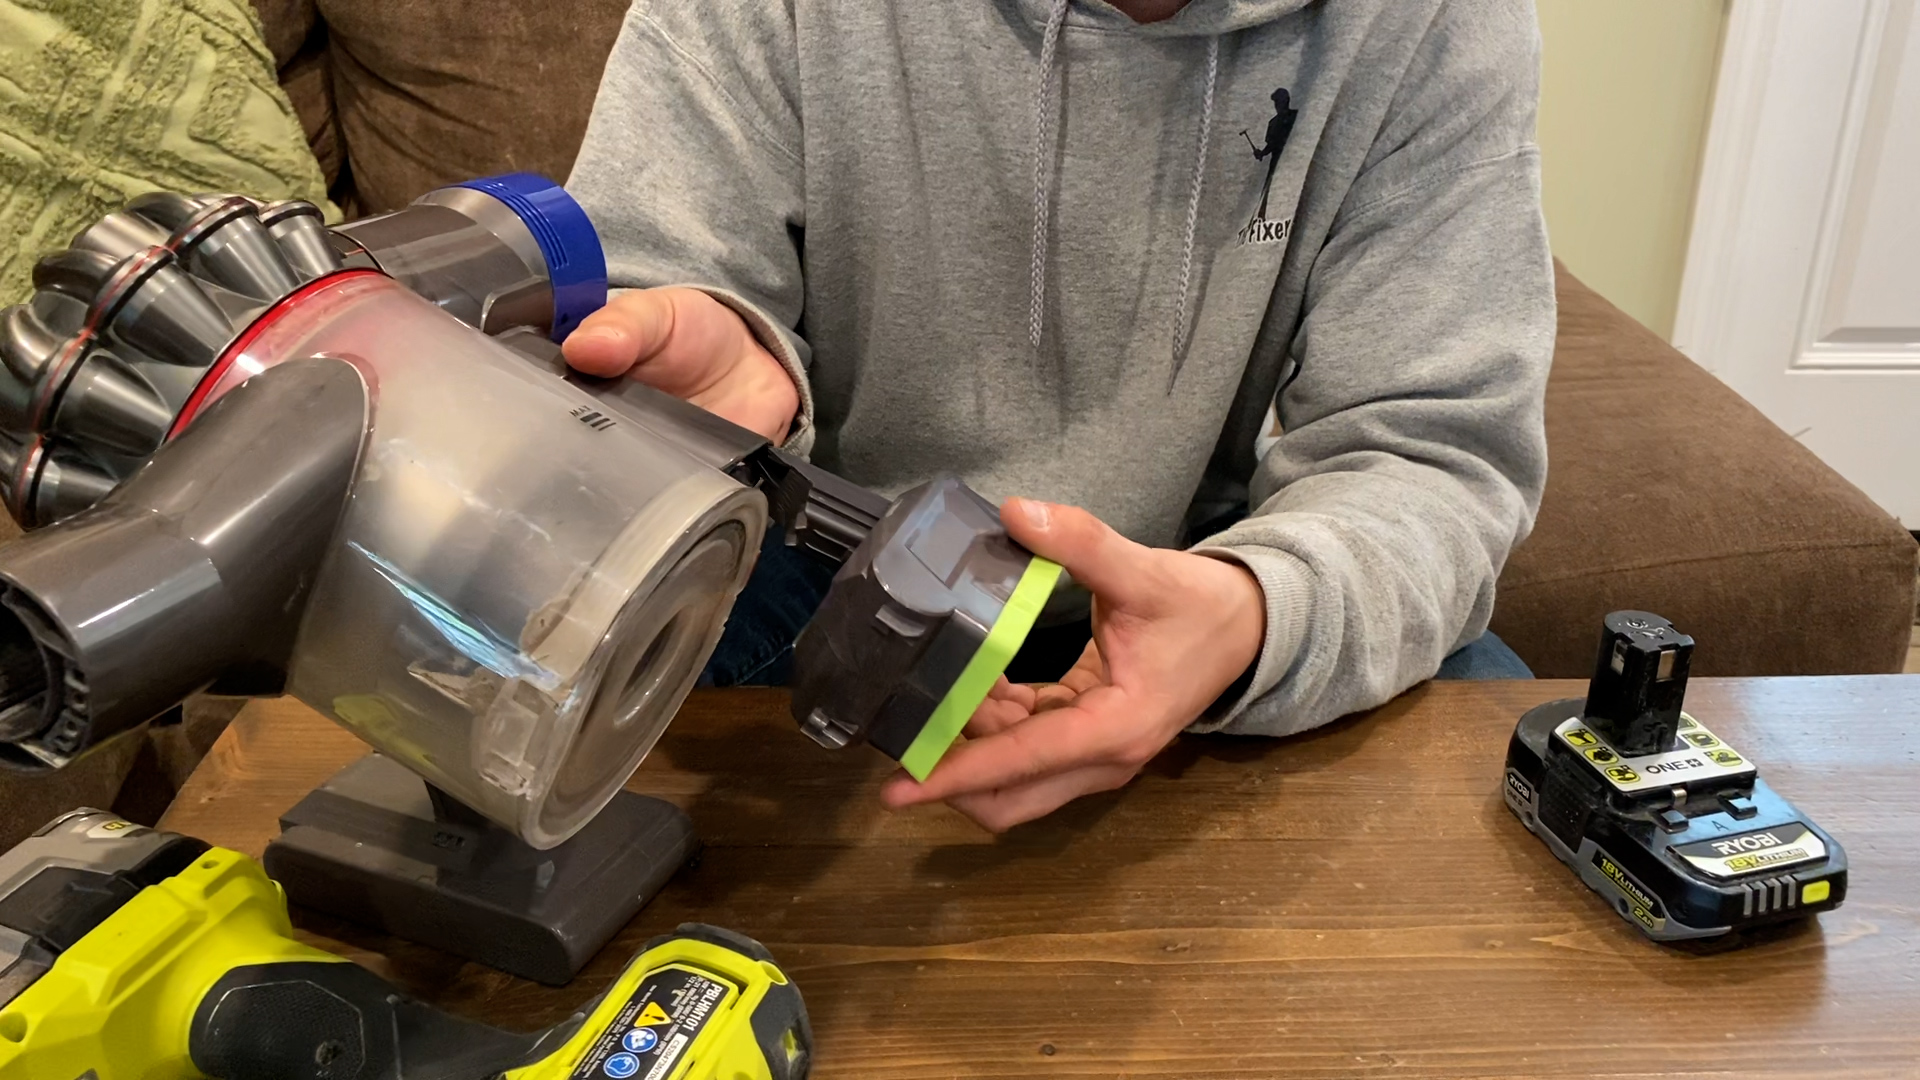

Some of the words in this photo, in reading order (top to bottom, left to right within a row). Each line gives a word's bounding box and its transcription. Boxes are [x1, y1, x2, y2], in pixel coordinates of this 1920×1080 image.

[569, 405, 592, 417] MAX
[1509, 773, 1530, 800] RYOBI
[1711, 820, 1729, 832] A
[1711, 832, 1783, 855] RYOBI
[682, 982, 724, 1032] PBLHM101
